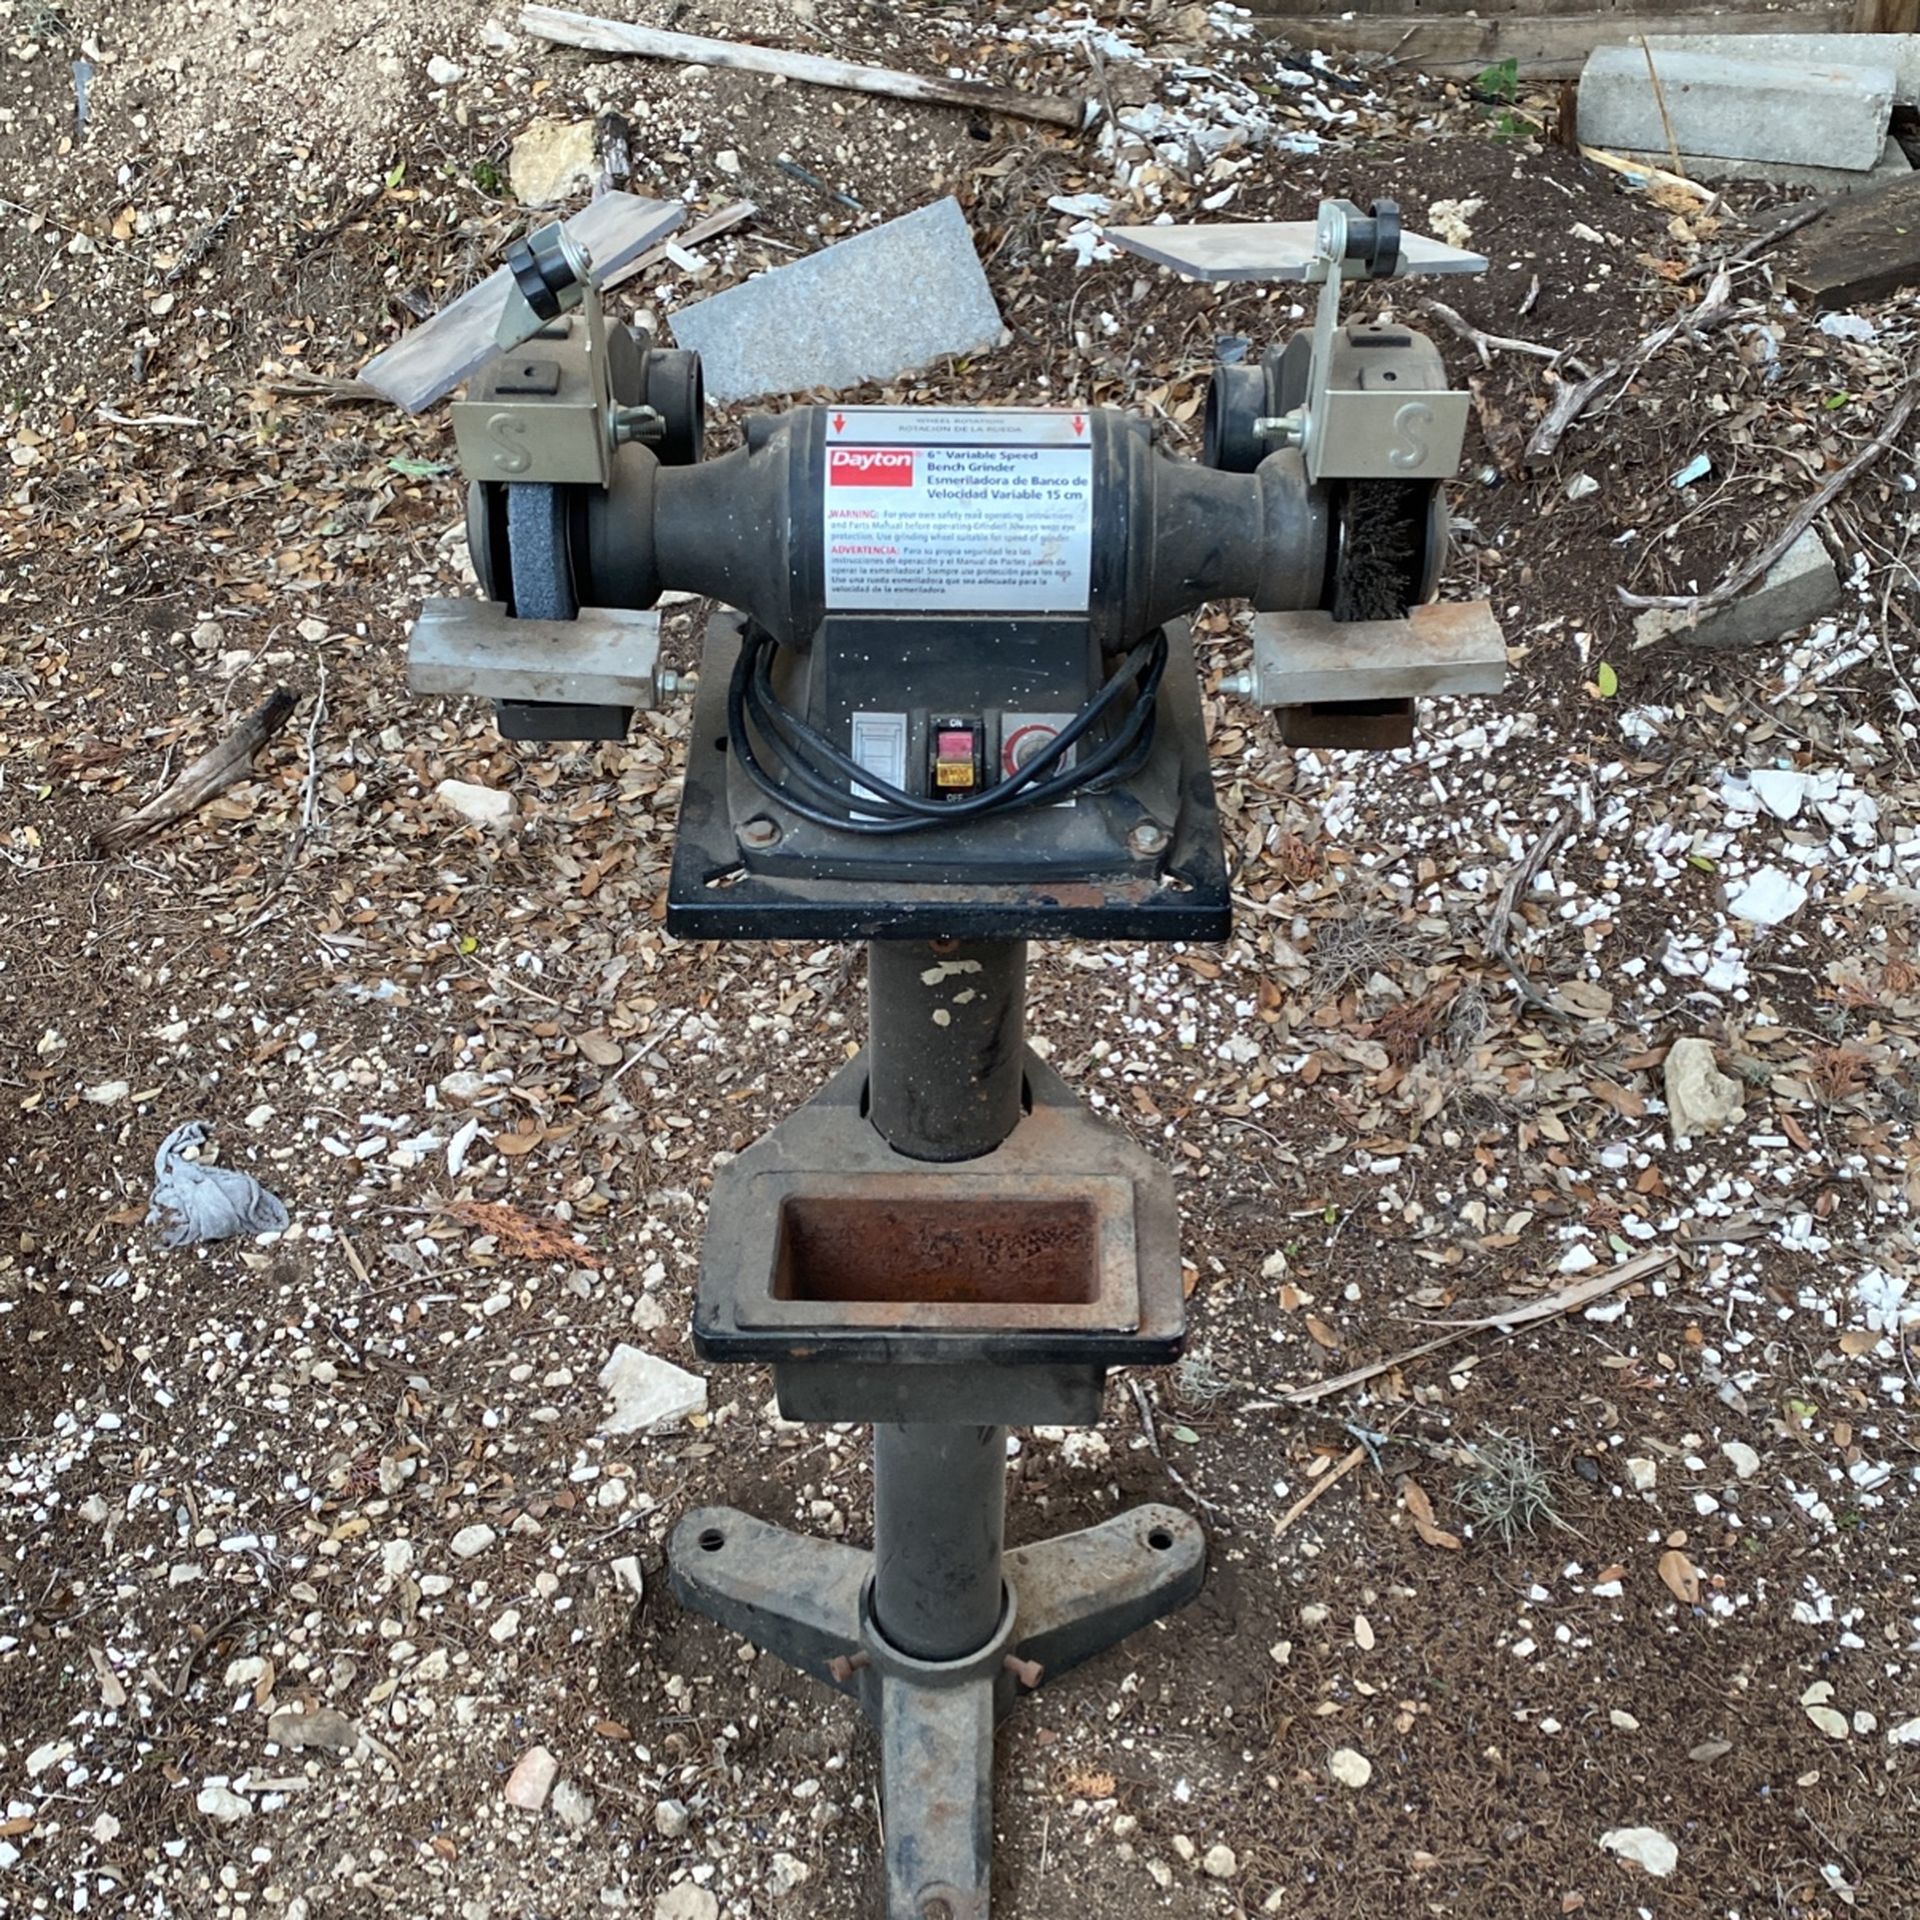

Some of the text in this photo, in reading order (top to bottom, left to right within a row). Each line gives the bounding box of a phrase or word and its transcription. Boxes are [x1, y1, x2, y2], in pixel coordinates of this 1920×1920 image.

[832, 452, 912, 471] Dayton
[946, 451, 996, 460] Variable
[1000, 452, 1038, 462] Speed
[927, 462, 1016, 472] Bench Grinder
[927, 475, 1088, 486] Esmeriladora de Banco de
[927, 488, 988, 499] Velocidad
[991, 490, 1042, 500] Variable
[1047, 490, 1061, 500] 15
[830, 510, 878, 518] WARNING:
[898, 512, 917, 521] your
[938, 511, 962, 521] safety
[965, 512, 982, 520] read
[984, 512, 1024, 522] operating
[932, 523, 972, 531] operating
[896, 533, 928, 542] grinding
[1004, 534, 1028, 542] speed
[1030, 534, 1040, 542] of
[832, 546, 901, 555] ADVERTENCIA:
[904, 546, 922, 554] Para
[935, 548, 961, 557] propia
[964, 548, 1002, 557] seguridad
[832, 557, 884, 565] instrucciones
[1000, 558, 1026, 566] Partes
[927, 568, 958, 576] Siempre
[978, 578, 1017, 586] adecuada
[949, 718, 963, 728] ON
[946, 793, 964, 803] OFF
